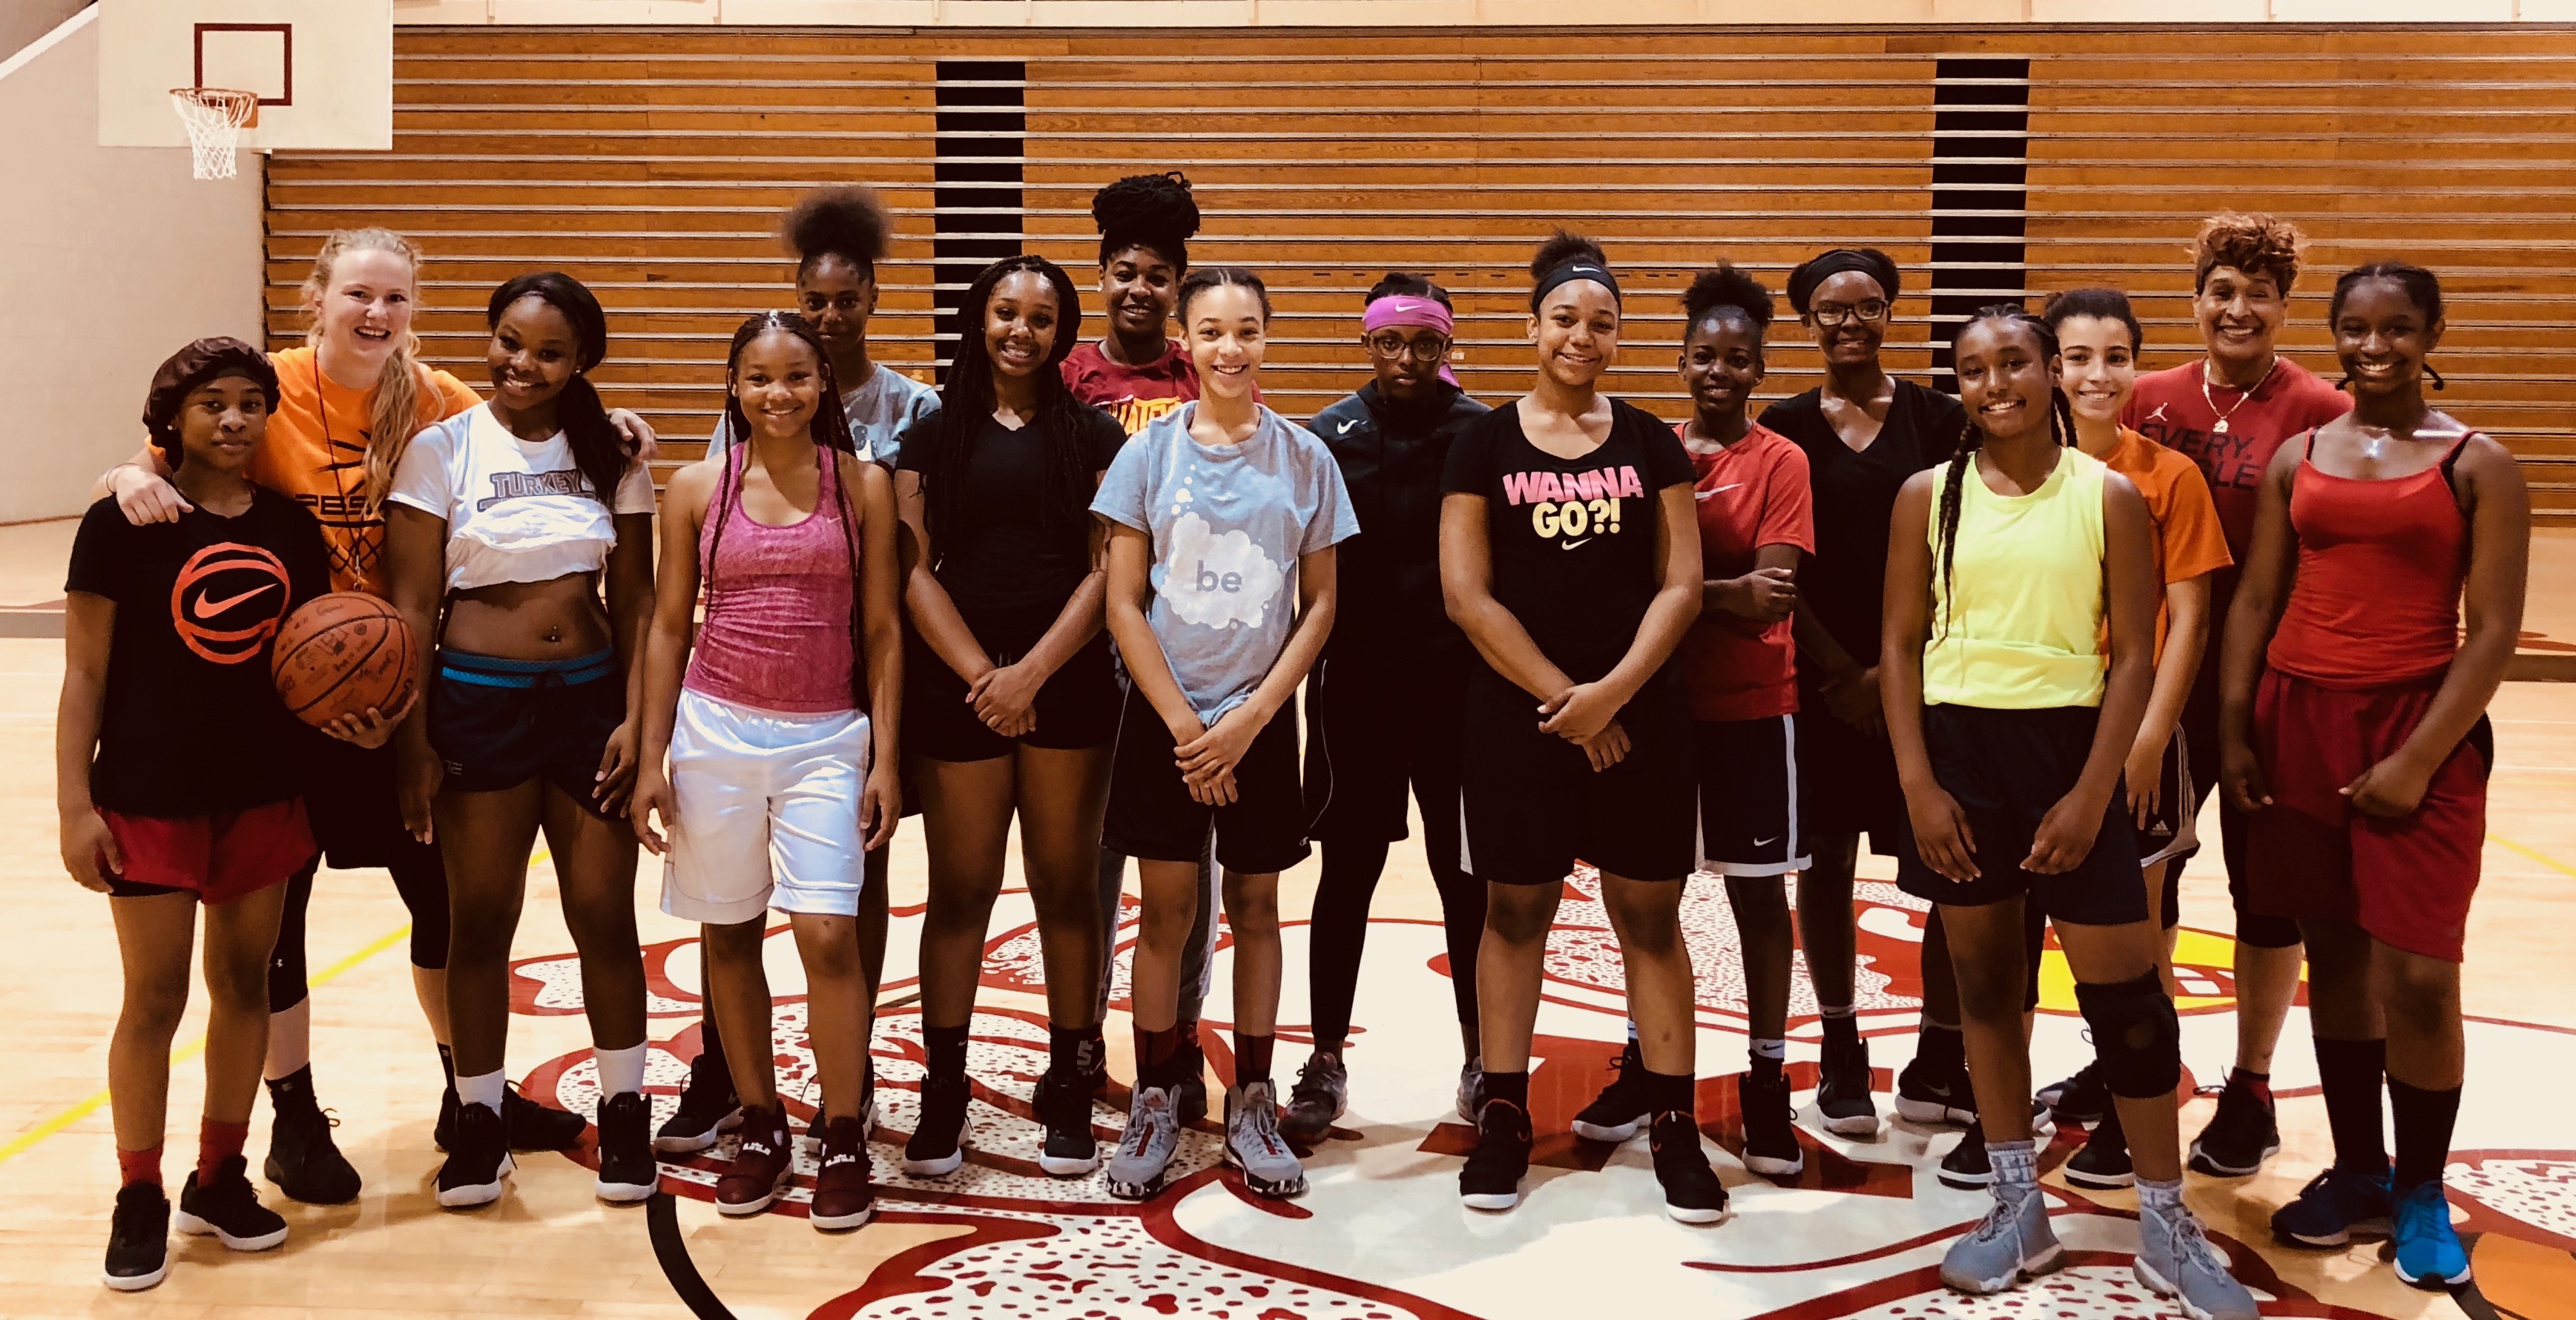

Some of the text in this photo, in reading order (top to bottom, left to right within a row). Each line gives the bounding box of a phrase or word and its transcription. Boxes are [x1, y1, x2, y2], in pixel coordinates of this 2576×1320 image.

[490, 469, 583, 498] TURKEY
[1502, 465, 1644, 506] WANNA
[1532, 498, 1621, 538] GO?!
[1196, 559, 1242, 593] be
